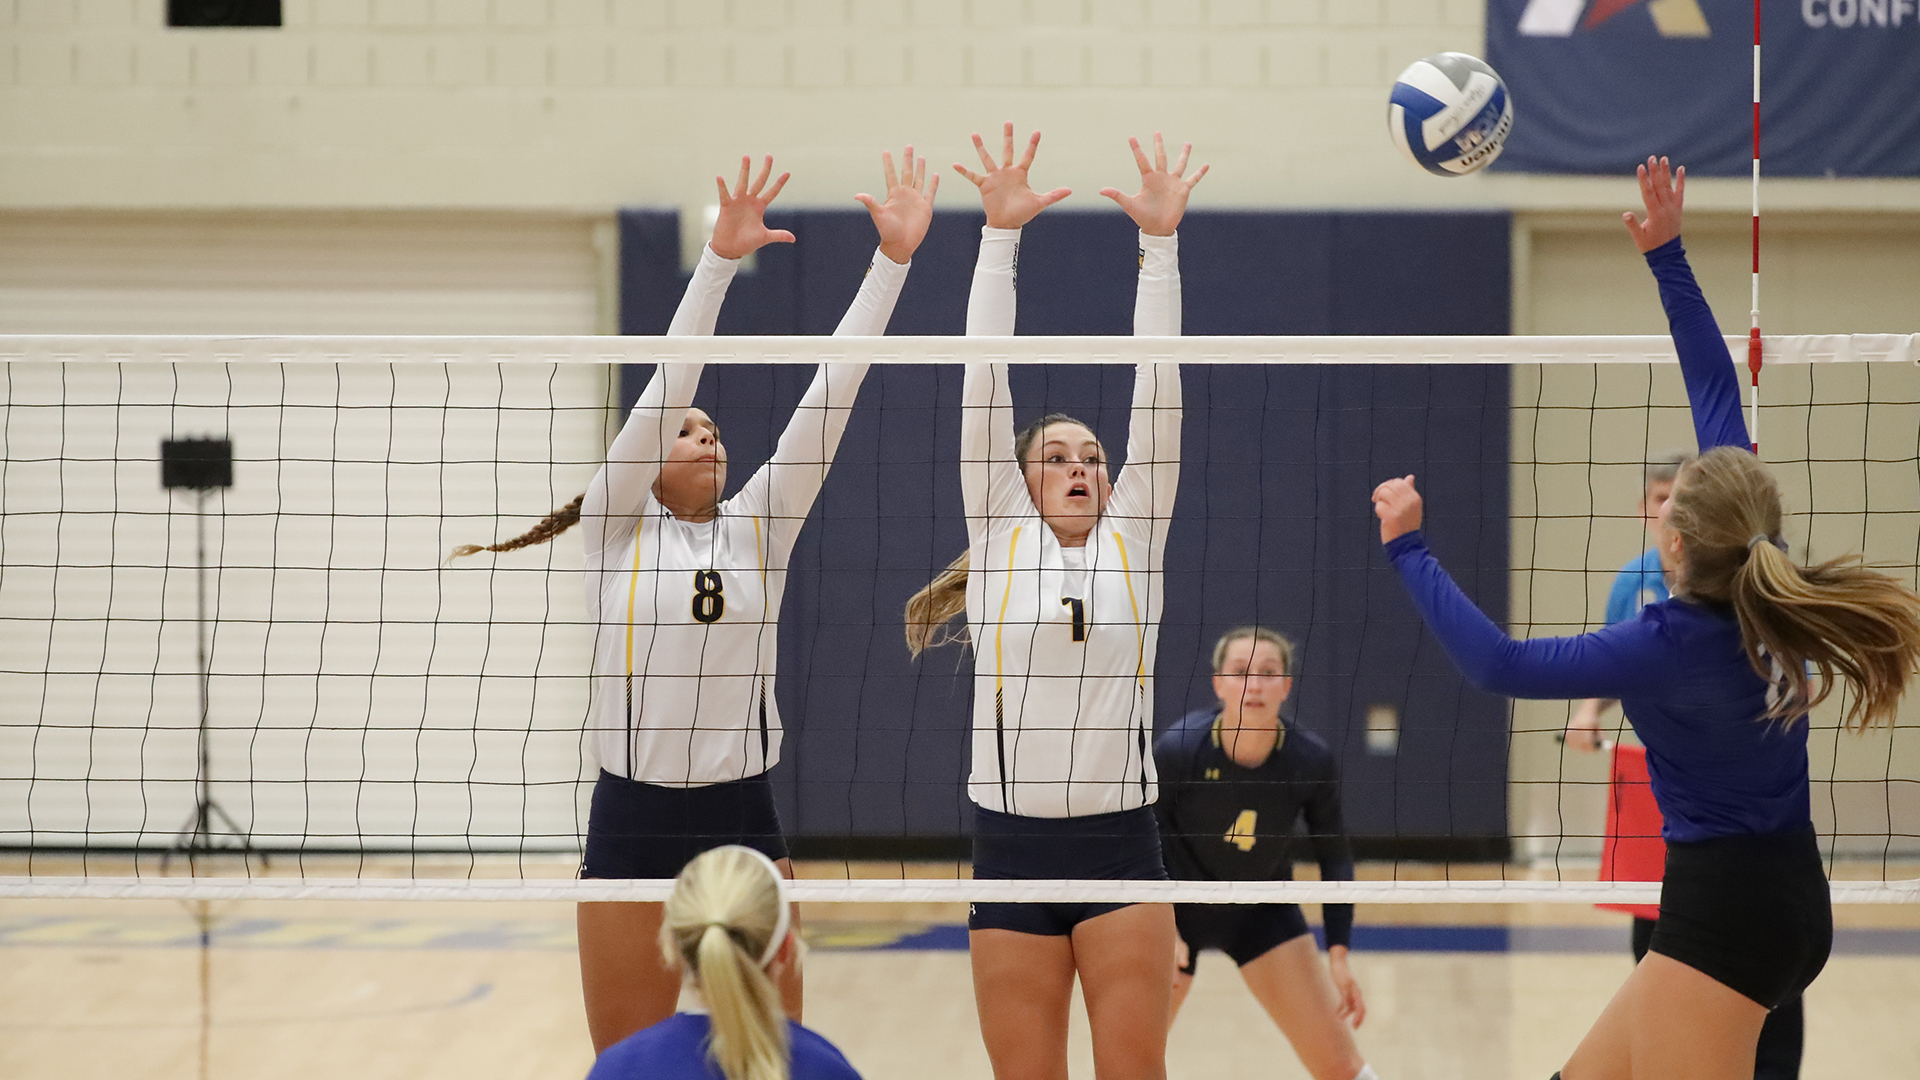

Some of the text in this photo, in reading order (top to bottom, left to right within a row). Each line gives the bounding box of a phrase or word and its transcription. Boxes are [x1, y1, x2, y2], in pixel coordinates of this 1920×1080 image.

[1801, 0, 1920, 28] CONF
[691, 569, 725, 624] 8
[1061, 597, 1085, 642] 1
[1223, 809, 1258, 852] 4
